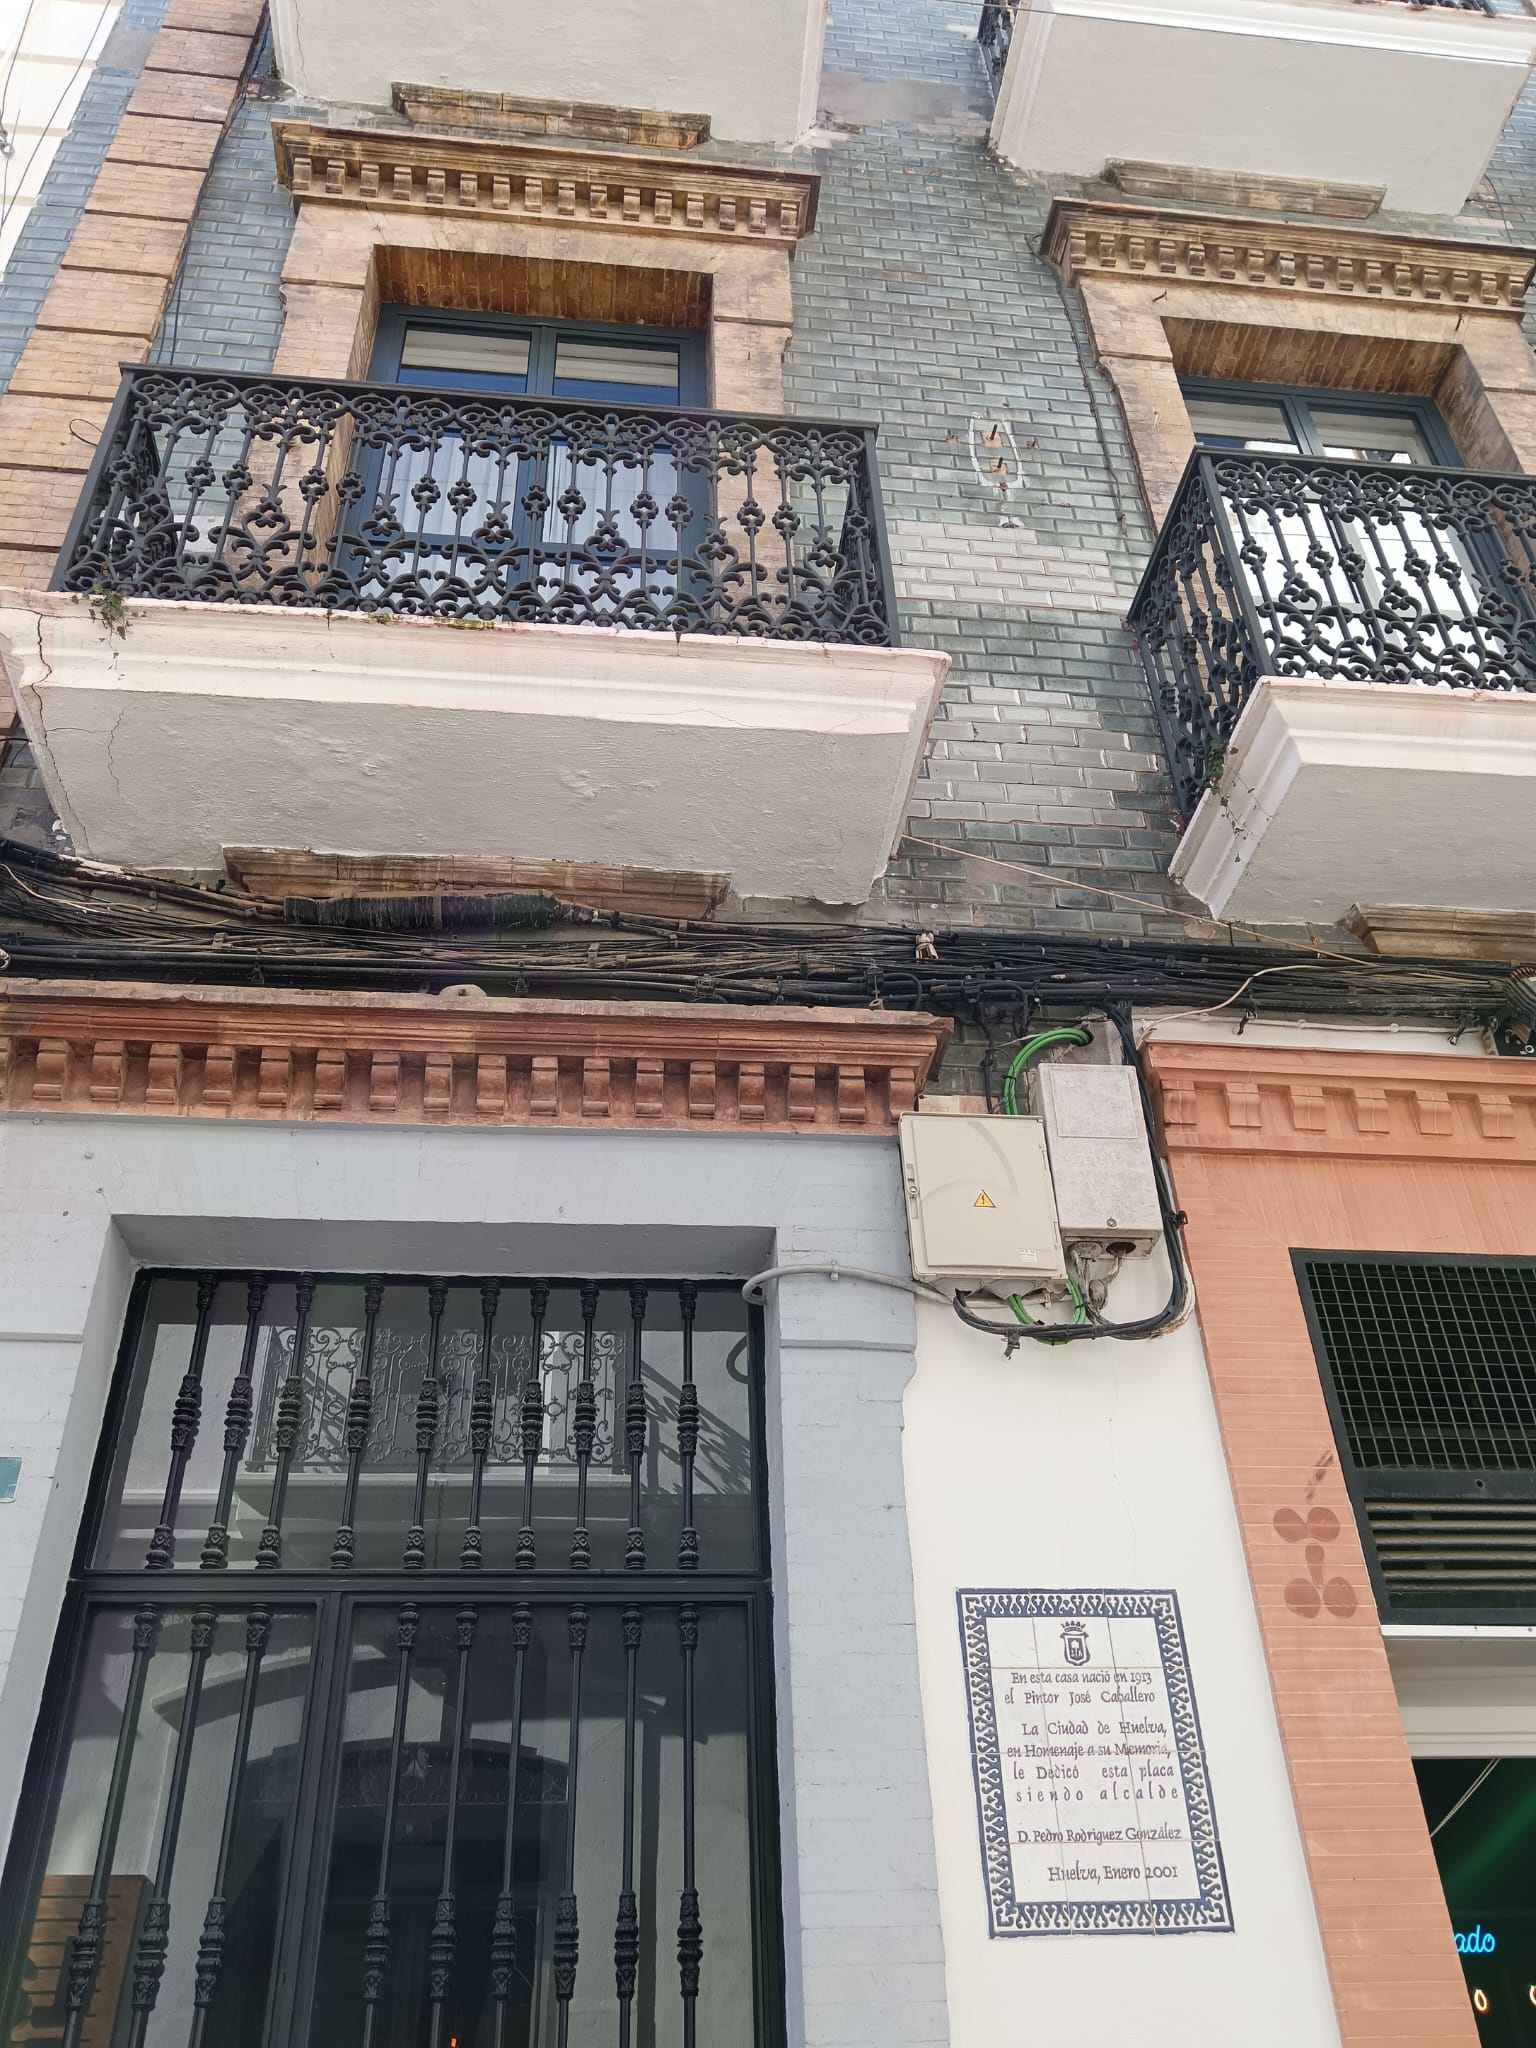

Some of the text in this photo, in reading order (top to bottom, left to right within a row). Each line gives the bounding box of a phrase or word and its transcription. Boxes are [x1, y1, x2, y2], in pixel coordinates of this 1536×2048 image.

[1011, 1670, 1152, 1685] En esta casa nació en 1913
[1004, 1686, 1155, 1706] el Pintor José Caballero
[1022, 1716, 1167, 1737] La Ciudad de Huelva,
[1007, 1740, 1171, 1760] en Homenaje a su Memoria,
[1013, 1759, 1174, 1781] le Dedicó esta placa
[1016, 1781, 1178, 1802] siendo alcalde
[1033, 1829, 1063, 1842] Pedro
[1125, 1822, 1182, 1840] González
[1048, 1860, 1178, 1885] Huelva, Enero 2001
